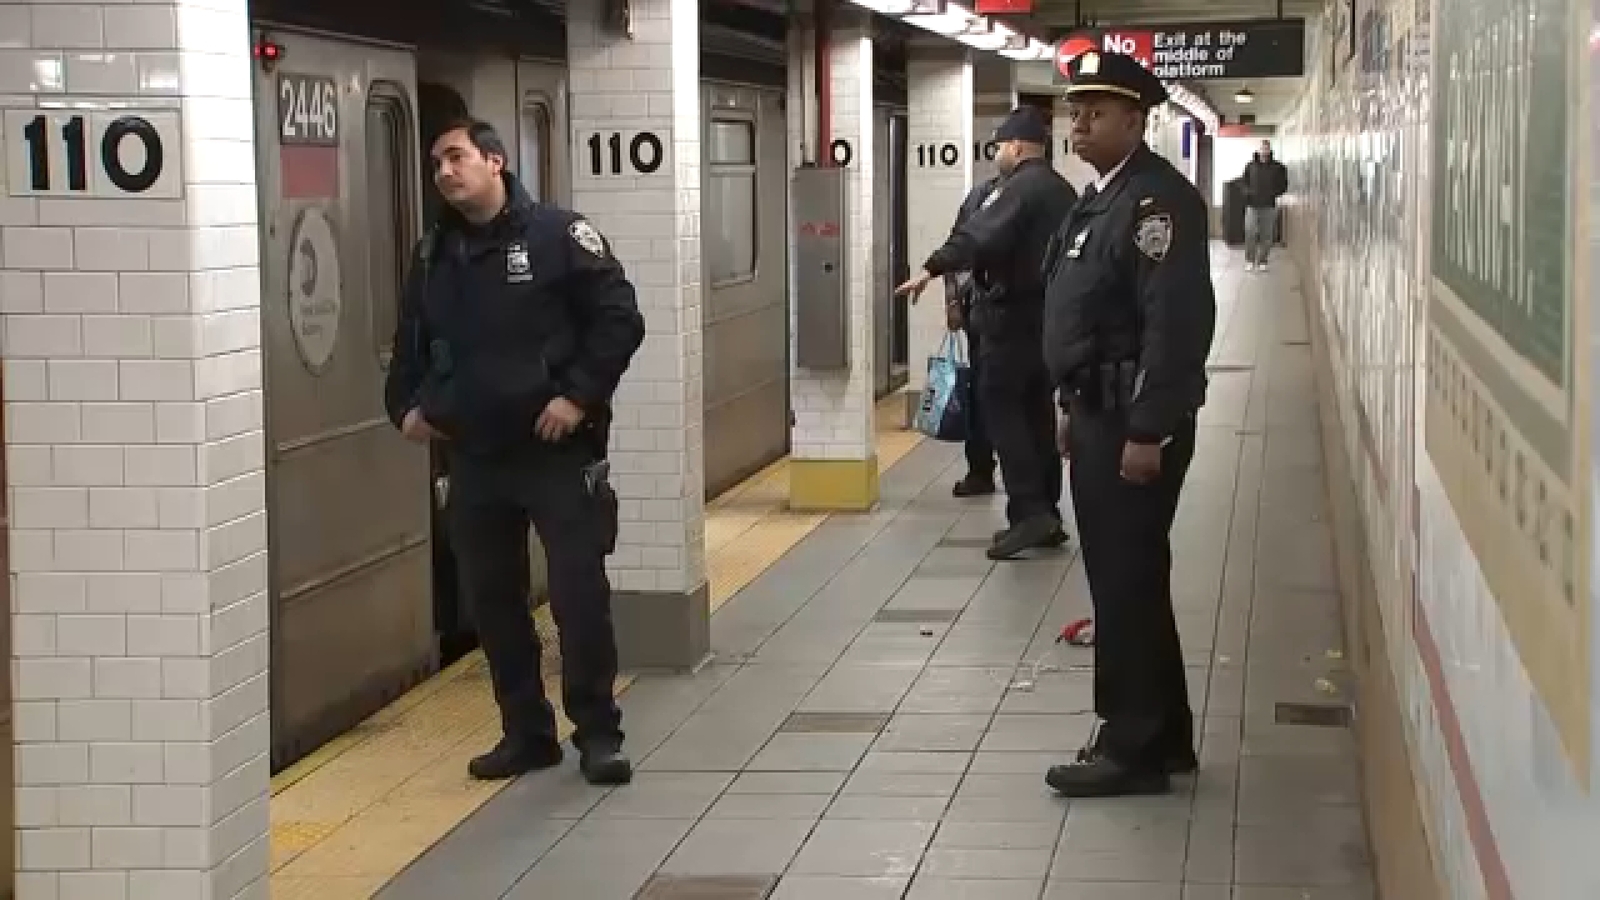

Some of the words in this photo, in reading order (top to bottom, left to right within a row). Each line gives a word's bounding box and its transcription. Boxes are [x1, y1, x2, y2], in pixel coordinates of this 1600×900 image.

[1103, 34, 1136, 54] No
[1154, 31, 1185, 47] Exit
[1194, 31, 1211, 46] at
[1219, 30, 1247, 46] the
[1154, 47, 1208, 63] middle
[1215, 47, 1234, 61] of
[1153, 62, 1225, 78] platform
[281, 78, 336, 138] 2446
[24, 115, 163, 193] 110
[587, 131, 663, 175] 110
[917, 143, 959, 168] 110
[973, 141, 1000, 161] 10
